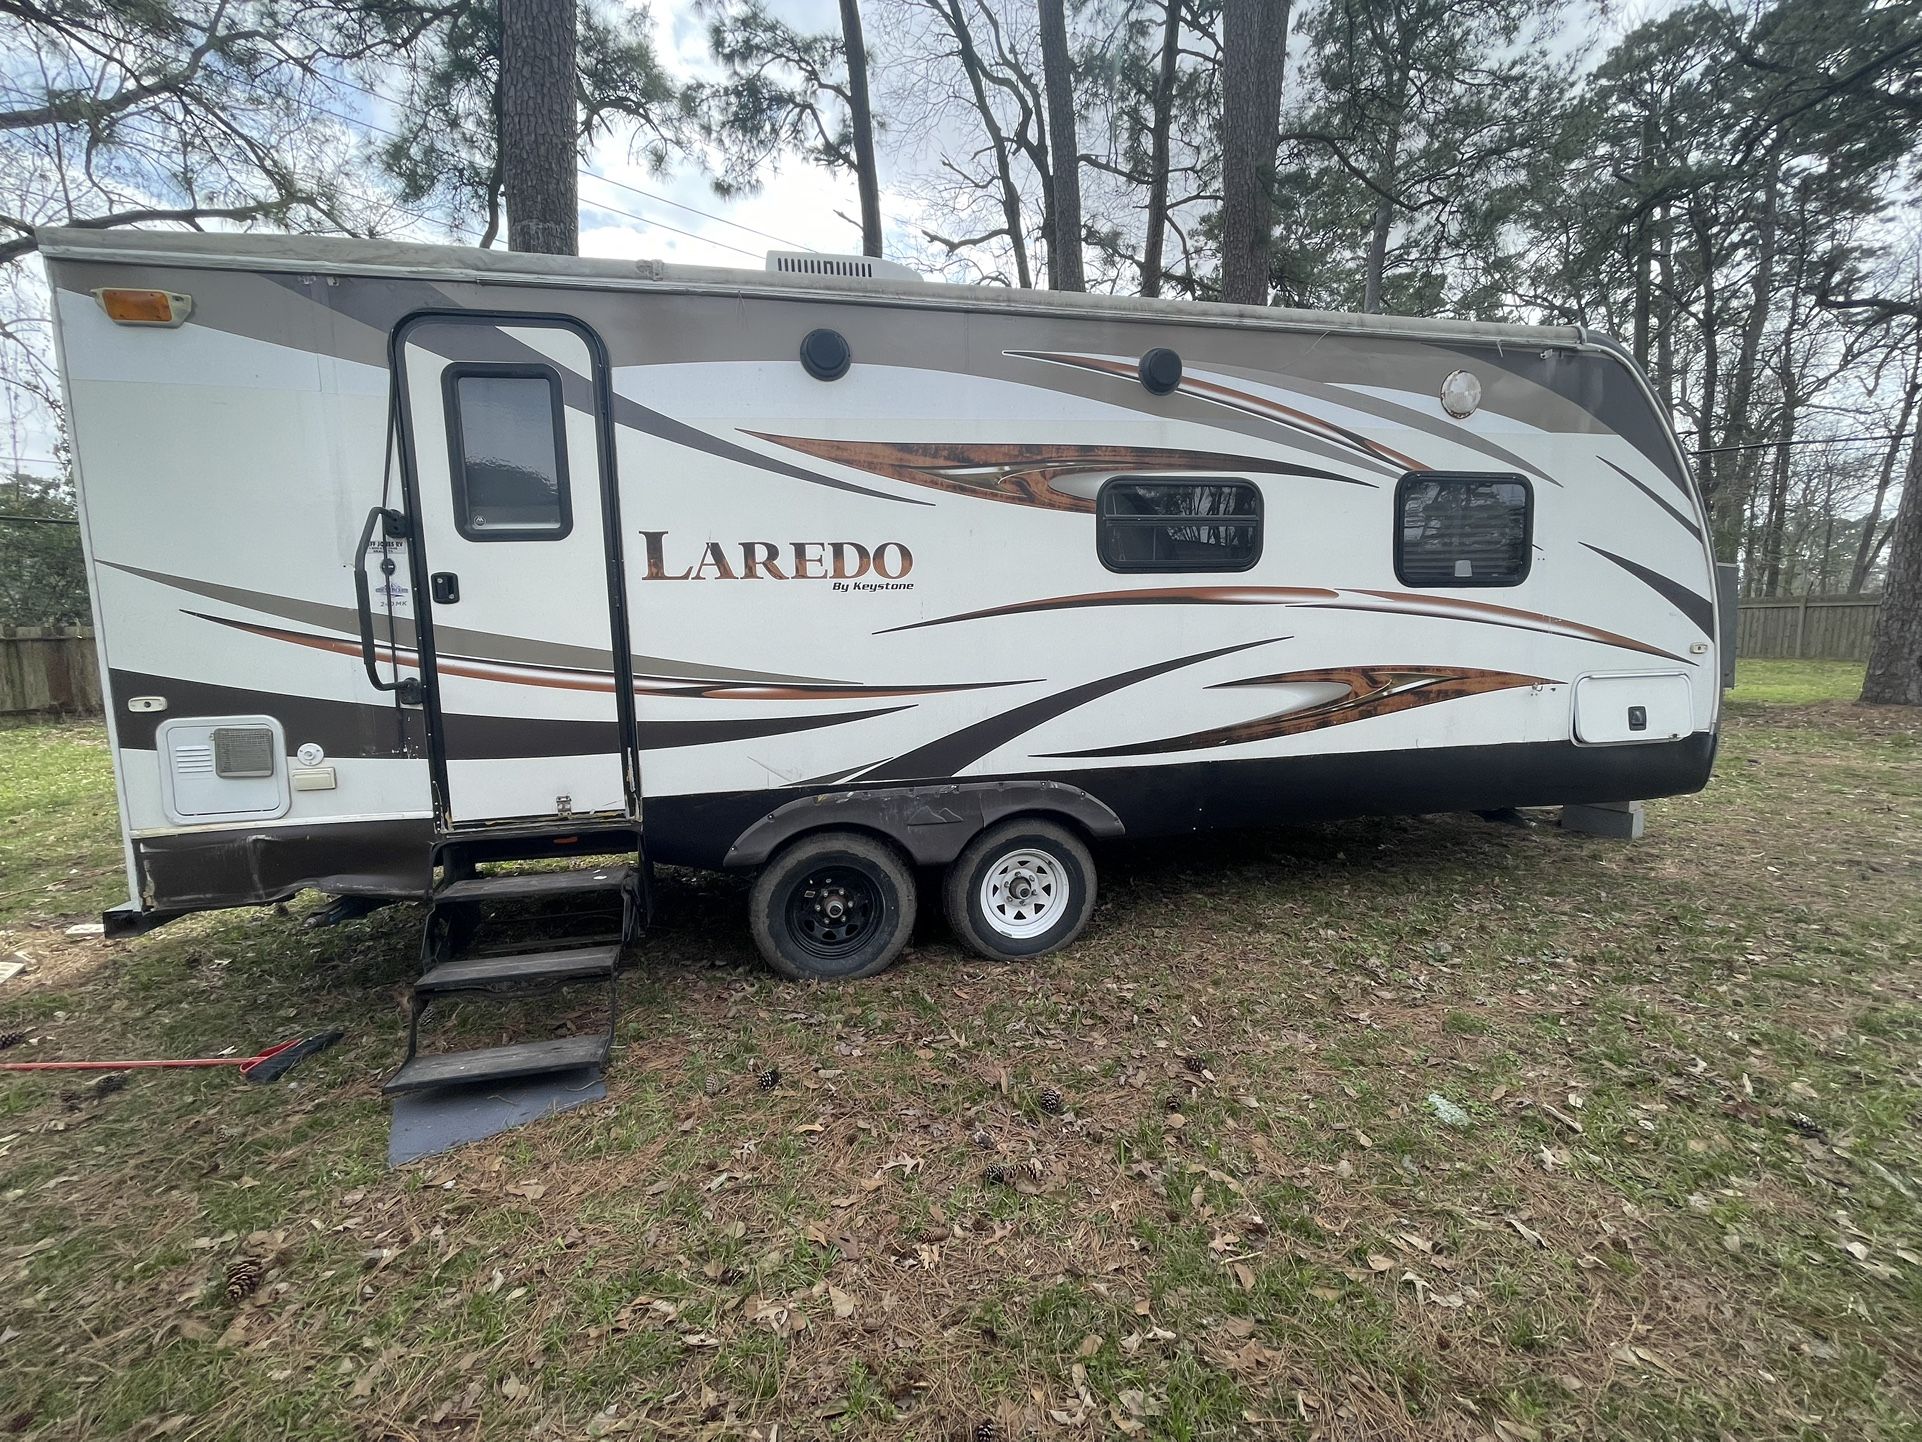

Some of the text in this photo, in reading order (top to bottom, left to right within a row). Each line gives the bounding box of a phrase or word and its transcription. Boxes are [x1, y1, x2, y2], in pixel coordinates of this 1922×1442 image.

[638, 530, 914, 581] LAREDO
[832, 581, 915, 593] By Keystone
